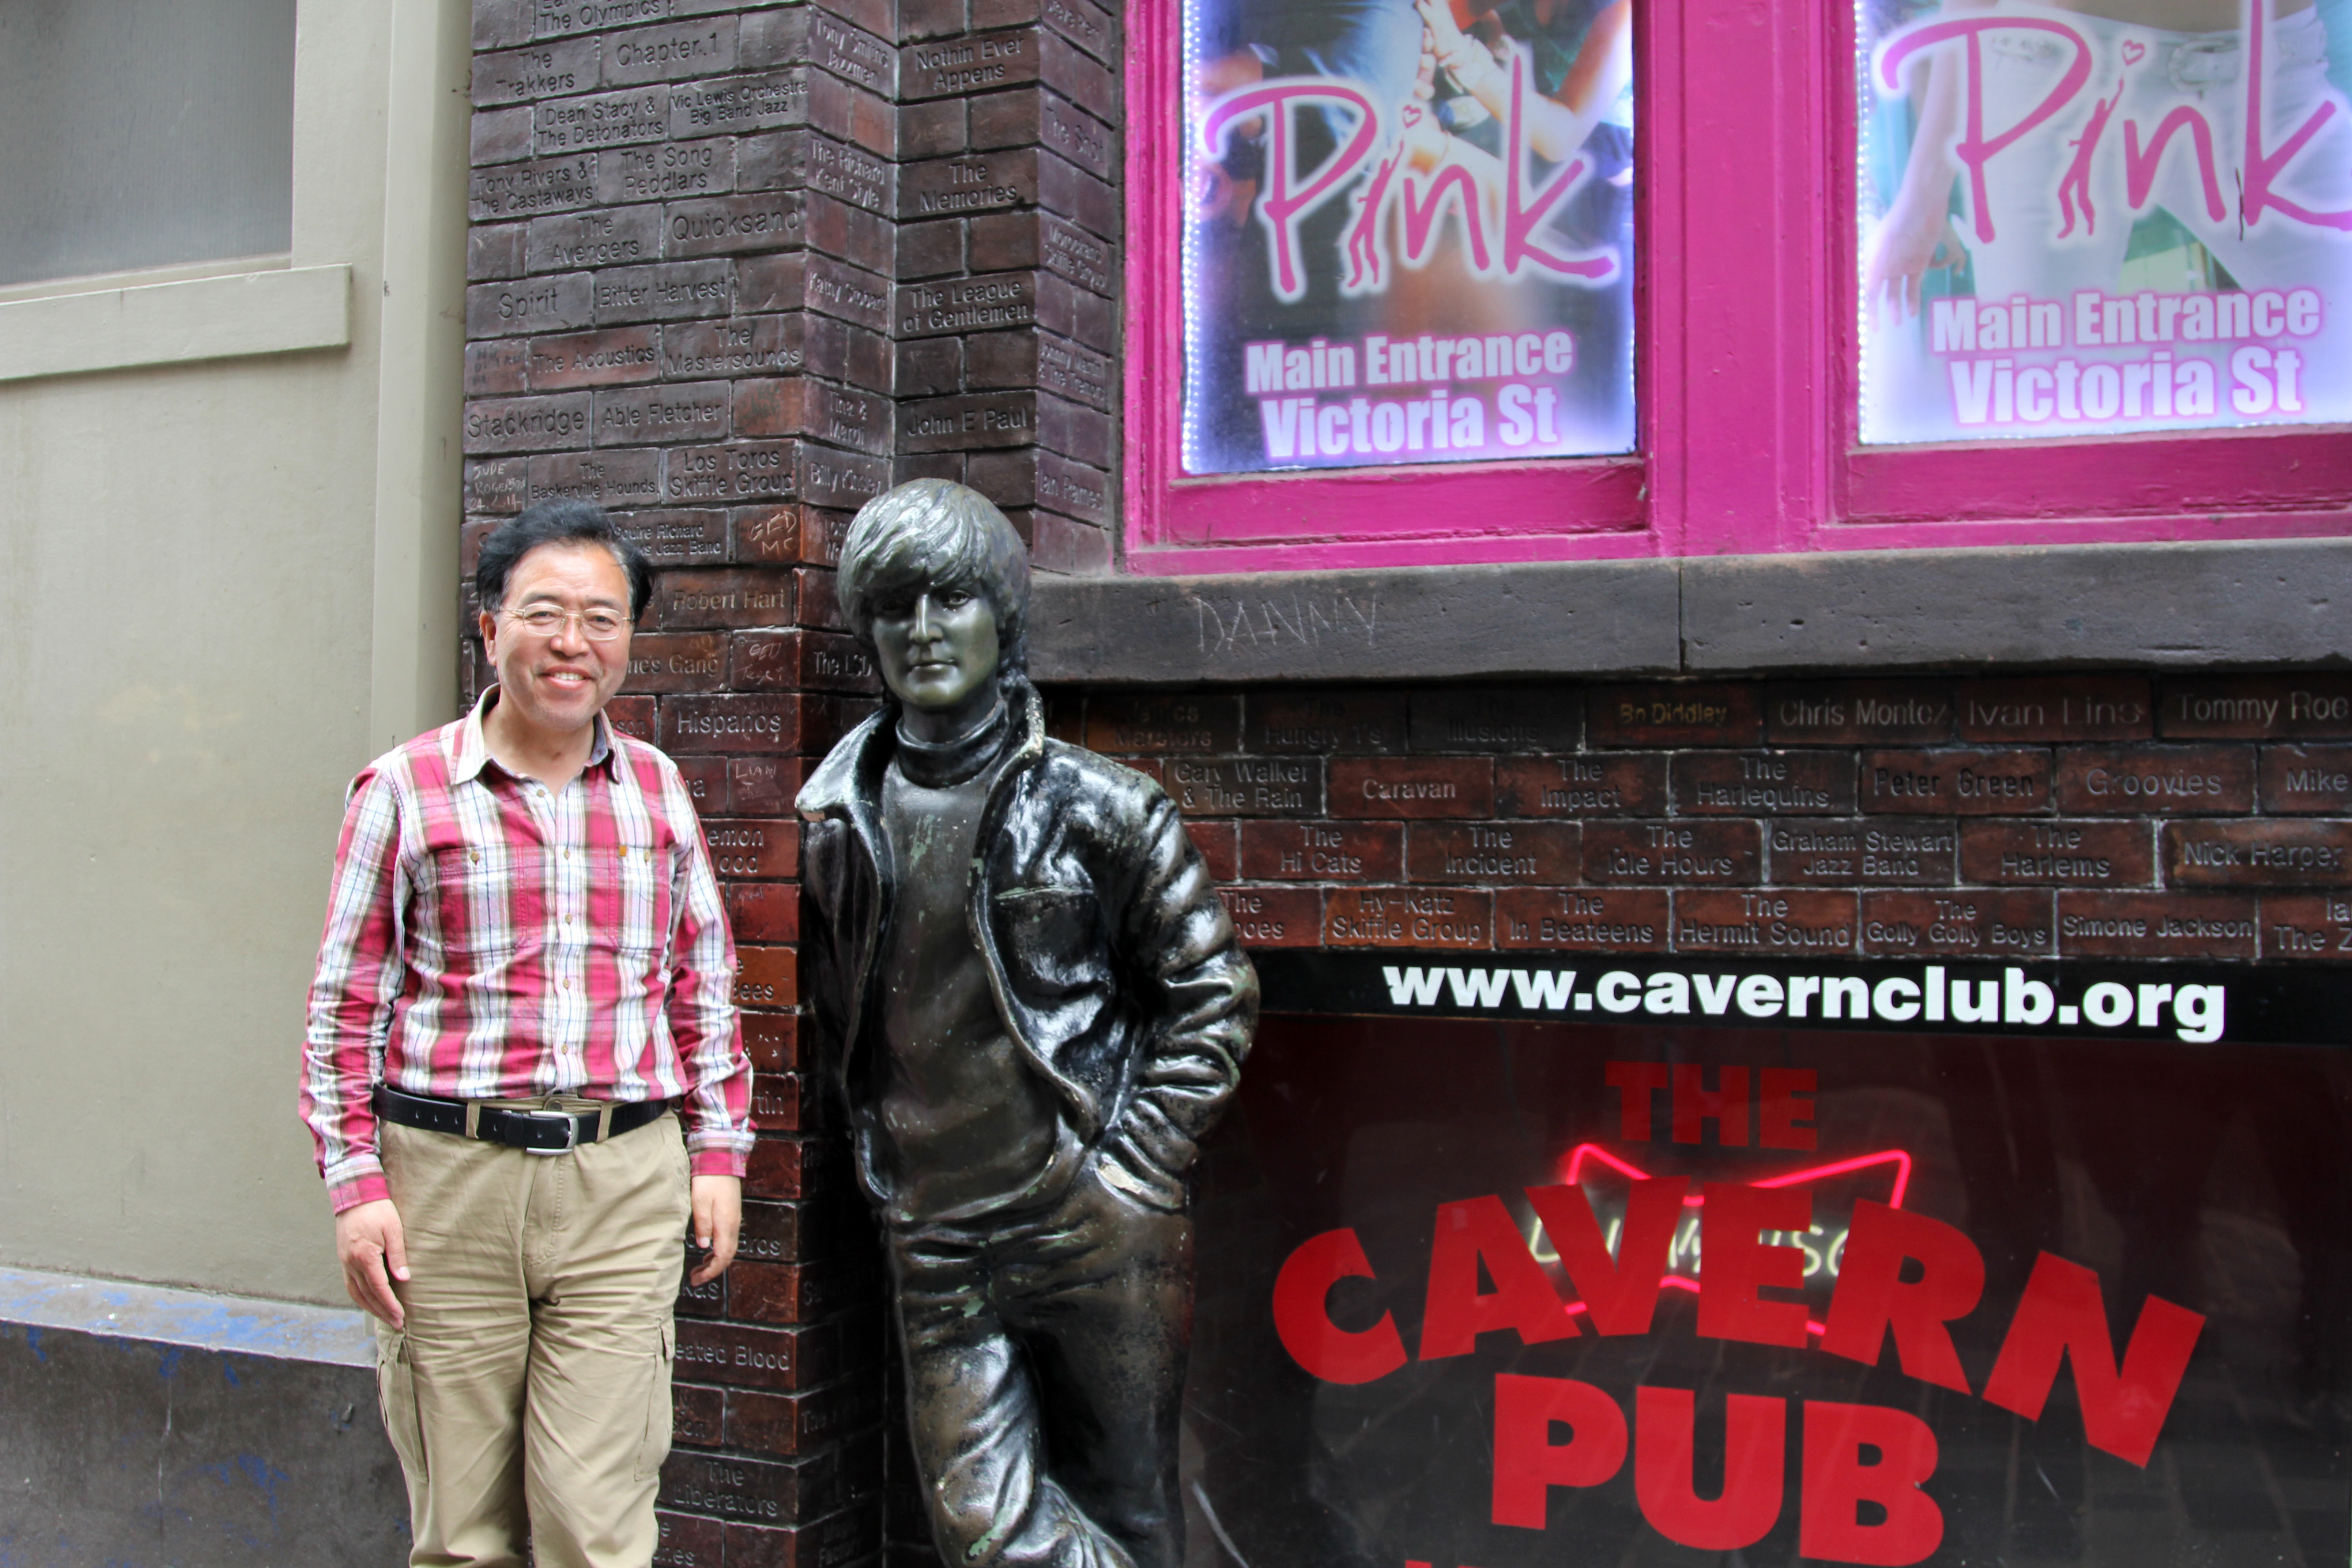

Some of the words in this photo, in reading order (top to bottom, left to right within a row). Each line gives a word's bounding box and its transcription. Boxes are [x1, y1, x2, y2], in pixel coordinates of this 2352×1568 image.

[540, 12, 572, 31] The
[581, 0, 660, 27] Olympics
[519, 52, 552, 69] The
[617, 39, 700, 66] Chapter
[710, 33, 717, 54] 1
[981, 37, 1025, 58] Ever
[496, 73, 574, 97] Trakkers
[670, 97, 691, 111] Vic
[697, 89, 734, 108] Lewis
[740, 80, 808, 100] Orchestra
[545, 107, 585, 126] Dean
[593, 101, 638, 122] Stacy
[645, 97, 655, 114] &
[691, 109, 711, 126] Big
[718, 105, 751, 121] Band
[757, 101, 788, 116] Jazz
[538, 131, 566, 147] The
[574, 120, 663, 144] Detonators
[621, 150, 655, 172] The
[664, 146, 712, 168] Song
[811, 139, 834, 164] The
[476, 176, 514, 191] Tony
[521, 166, 570, 186] Rivers
[577, 163, 586, 180] &
[625, 173, 708, 197] Peddlars
[949, 163, 987, 185] The
[1204, 51, 1616, 294] Pink
[470, 198, 499, 214] The
[506, 187, 593, 210] Castaways
[920, 184, 1018, 213] Memories
[578, 217, 612, 238] The
[552, 240, 639, 267] Avengers
[500, 287, 558, 324] Spirit
[600, 284, 649, 308] Bitter
[655, 277, 725, 303] Harvest
[911, 289, 943, 309] The
[952, 280, 1022, 306] League
[903, 318, 921, 333] of
[928, 304, 1028, 328] Gentlemen
[1933, 297, 2062, 352] Main
[2076, 289, 2320, 346] Entrance
[716, 327, 751, 348] The
[534, 355, 565, 374] The
[572, 344, 655, 370] Acoustics
[667, 349, 800, 375] Mastersounds
[1247, 339, 1355, 393] Main
[1367, 331, 1572, 385] Entrance
[1951, 350, 2215, 424] Victoria
[2232, 346, 2302, 415] St
[468, 410, 585, 438] Stackridge
[602, 408, 642, 428] Able
[647, 403, 721, 424] Fletcher
[908, 413, 953, 436] John
[962, 413, 976, 431] E
[984, 408, 1026, 431] Paul
[1262, 387, 1485, 458] Victoria
[1498, 384, 1558, 445] St
[581, 462, 605, 478] The
[684, 451, 716, 472] Los
[727, 448, 780, 468] Toros
[670, 473, 728, 498] Skiffle
[735, 472, 792, 495] Group
[811, 462, 838, 493] Billy
[657, 522, 704, 539] Richard
[656, 540, 684, 556] Jazz
[672, 588, 736, 611] Robert
[744, 587, 785, 609] Hart
[1192, 593, 1377, 653] DANNY
[669, 653, 719, 676] Gang
[814, 651, 839, 675] The
[1651, 702, 1727, 726] Diddley
[1780, 699, 1845, 726] Chris
[1856, 699, 1946, 725] Montez
[1969, 699, 2044, 726] Ivan
[2063, 696, 2142, 725] Lins
[2176, 693, 2278, 728] Tommy
[2291, 692, 2350, 720] Roe
[1174, 763, 1222, 787] Gary
[1235, 763, 1310, 783] Walker
[1557, 760, 1603, 781] The
[1739, 757, 1787, 780] The
[2287, 769, 2349, 793] Mike
[1362, 779, 1457, 800] Caravan
[1874, 768, 1941, 796] Peter
[1957, 766, 2034, 798] Green
[2086, 768, 2223, 796] Groovies
[1181, 788, 1196, 808] &
[1206, 787, 1245, 809] The
[1255, 788, 1303, 808] Rain
[1541, 785, 1621, 812] Impact
[1697, 783, 1829, 811] Harlequins
[1300, 826, 1342, 848] The
[1469, 827, 1513, 849] The
[1646, 826, 1693, 848] The
[1772, 830, 1857, 852] Graham
[1865, 830, 1953, 853] Stewart
[2030, 826, 2081, 849] The
[1281, 852, 1302, 873] Hi
[1311, 851, 1362, 875] Cats
[1445, 852, 1537, 876] Incident
[1607, 849, 1650, 875] Idle
[1660, 853, 1733, 876] Hours
[1803, 858, 1852, 876] Jazz
[1862, 855, 1918, 877] Band
[2001, 854, 2111, 879] Harlems
[2184, 842, 2240, 866] Nick
[2251, 843, 2342, 872] Harper
[1220, 891, 1262, 913] The
[1558, 893, 1604, 915] The
[1742, 894, 1788, 918] The
[1934, 900, 1978, 920] The
[1333, 917, 1402, 940] Skiffle
[1411, 917, 1481, 945] Group
[1509, 920, 1529, 941] In
[1539, 919, 1654, 943] Beateens
[1680, 919, 1759, 945] Hermit
[1769, 922, 1850, 947] Sound
[1866, 921, 1920, 946] Golly
[1928, 923, 1982, 948] Golly
[1991, 925, 2047, 949] Boys
[2062, 915, 2147, 938] Simone
[2156, 916, 2253, 938] Jackson
[2274, 925, 2326, 951] The
[1383, 964, 2225, 1043] www.cavernclub.org
[1604, 1060, 1818, 1152] THE
[1271, 1174, 2206, 1469] CAVERN
[736, 1345, 789, 1371] Blood
[706, 1461, 745, 1487] The
[1490, 1372, 1944, 1567] PUB
[673, 1485, 778, 1518] Liberators
